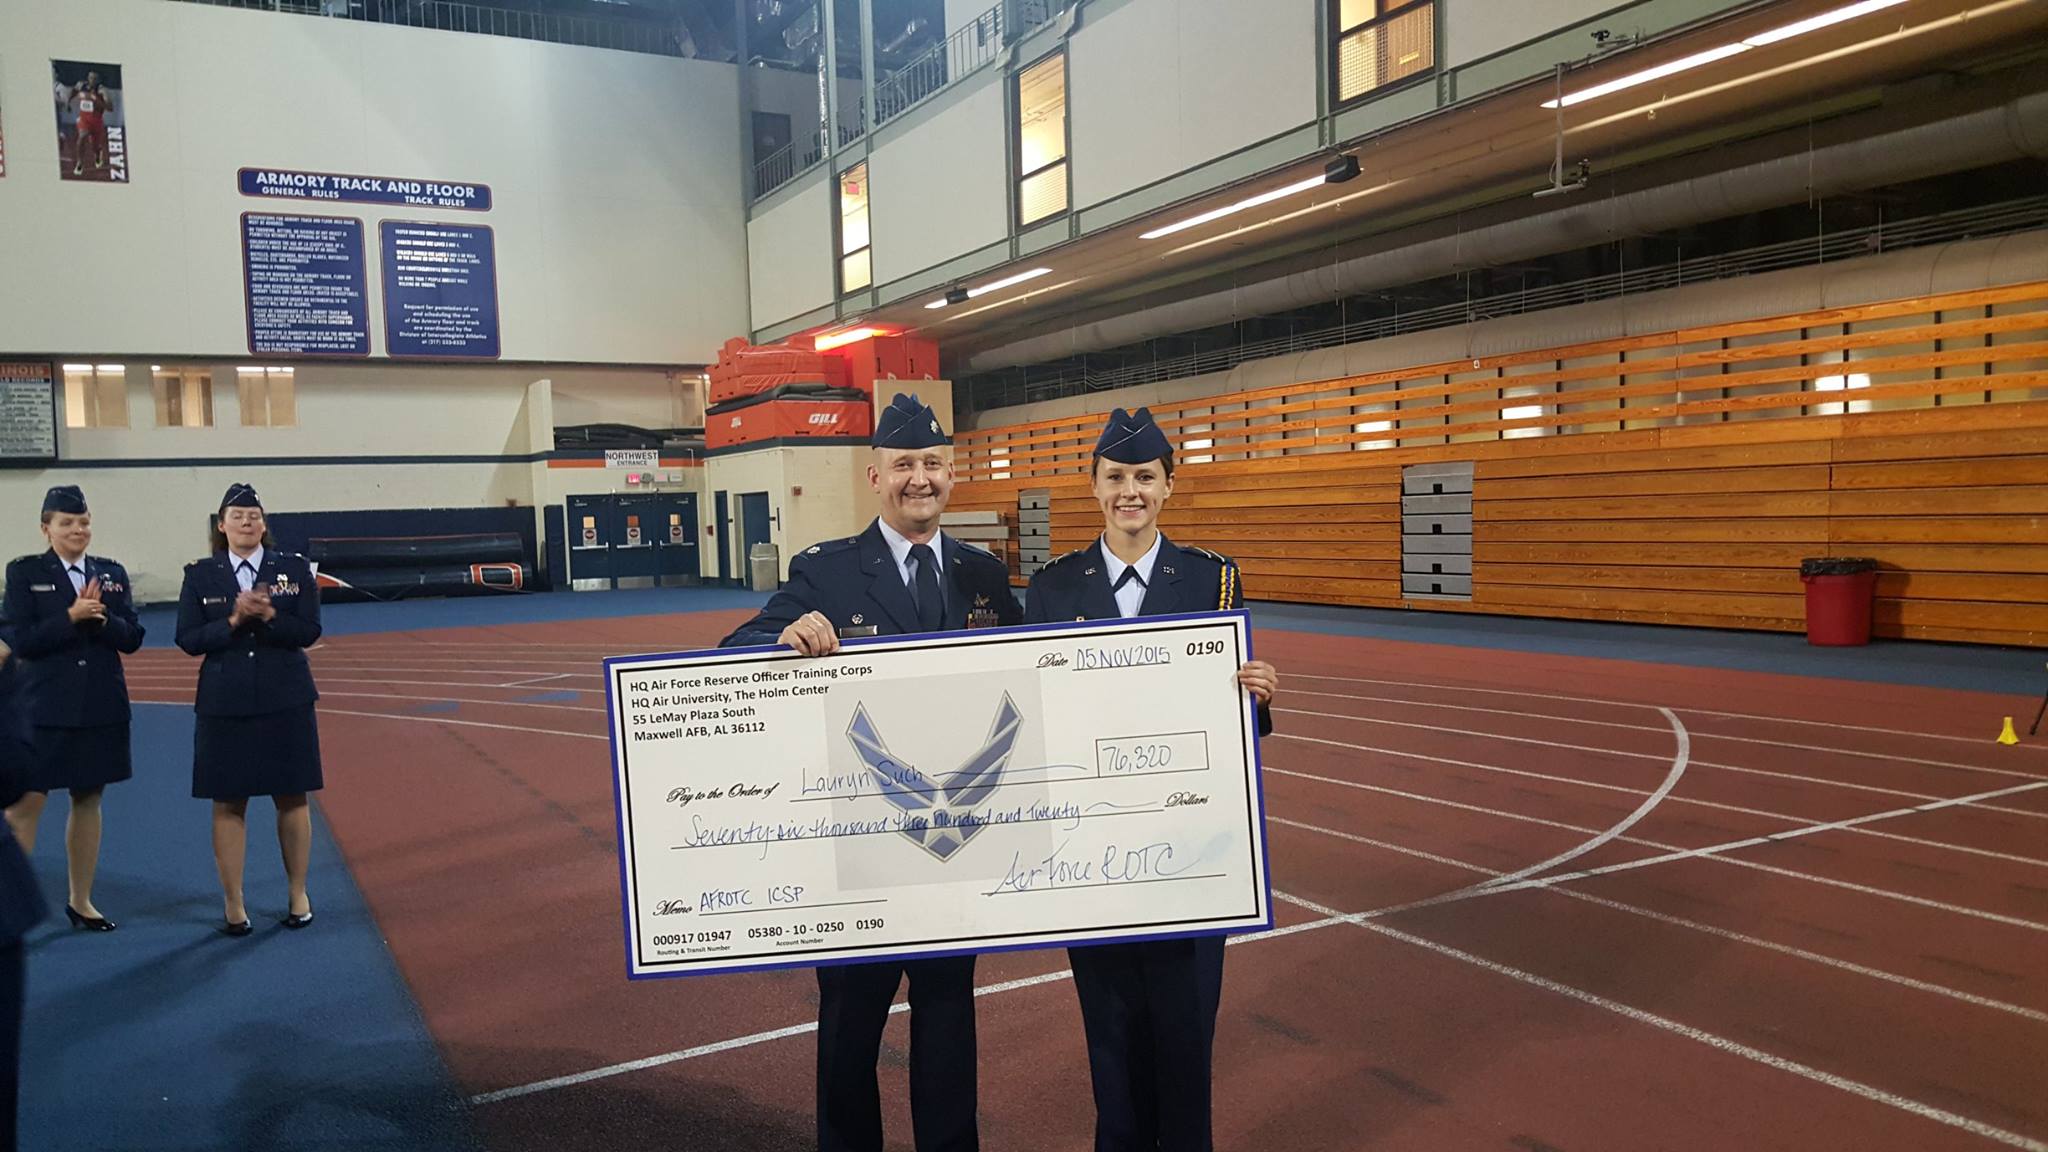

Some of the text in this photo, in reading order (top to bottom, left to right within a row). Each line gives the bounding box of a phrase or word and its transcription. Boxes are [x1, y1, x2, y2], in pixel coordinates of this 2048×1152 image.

[107, 126, 126, 180] ZAHN
[256, 172, 475, 198] ARMORY TRACK AND FLOOR
[262, 186, 340, 199] GENERAL RULES
[404, 195, 466, 207] TRACK RULES
[808, 413, 838, 425] GILL
[606, 452, 658, 460] NORTHWEST
[1186, 640, 1225, 656] 0190
[1036, 652, 1069, 669] Date
[630, 664, 873, 694] HQ Air Force Reserve Officer Training Corps
[631, 684, 830, 710] HQ Air University, The Holm Center
[632, 706, 756, 725] 55 LeMay Plaza South
[634, 722, 766, 742] Maxwell AFB, AL 36112
[1102, 744, 1172, 772] 76,320
[801, 760, 923, 801] Lauryn Such
[666, 782, 780, 807] Pay to the Order of
[1164, 791, 1210, 808] Dollars
[808, 816, 888, 837] thousand
[893, 808, 929, 832] three
[934, 808, 992, 828] hundred
[994, 806, 1022, 824] and
[1102, 842, 1201, 885] ROTC
[652, 900, 693, 917] Memo
[699, 886, 804, 912] AFROTC ICSP
[748, 926, 783, 938] 05380
[793, 924, 807, 936] 10
[816, 922, 845, 933] 0250
[856, 918, 884, 930] 0190
[652, 930, 732, 946] 000917 01947
